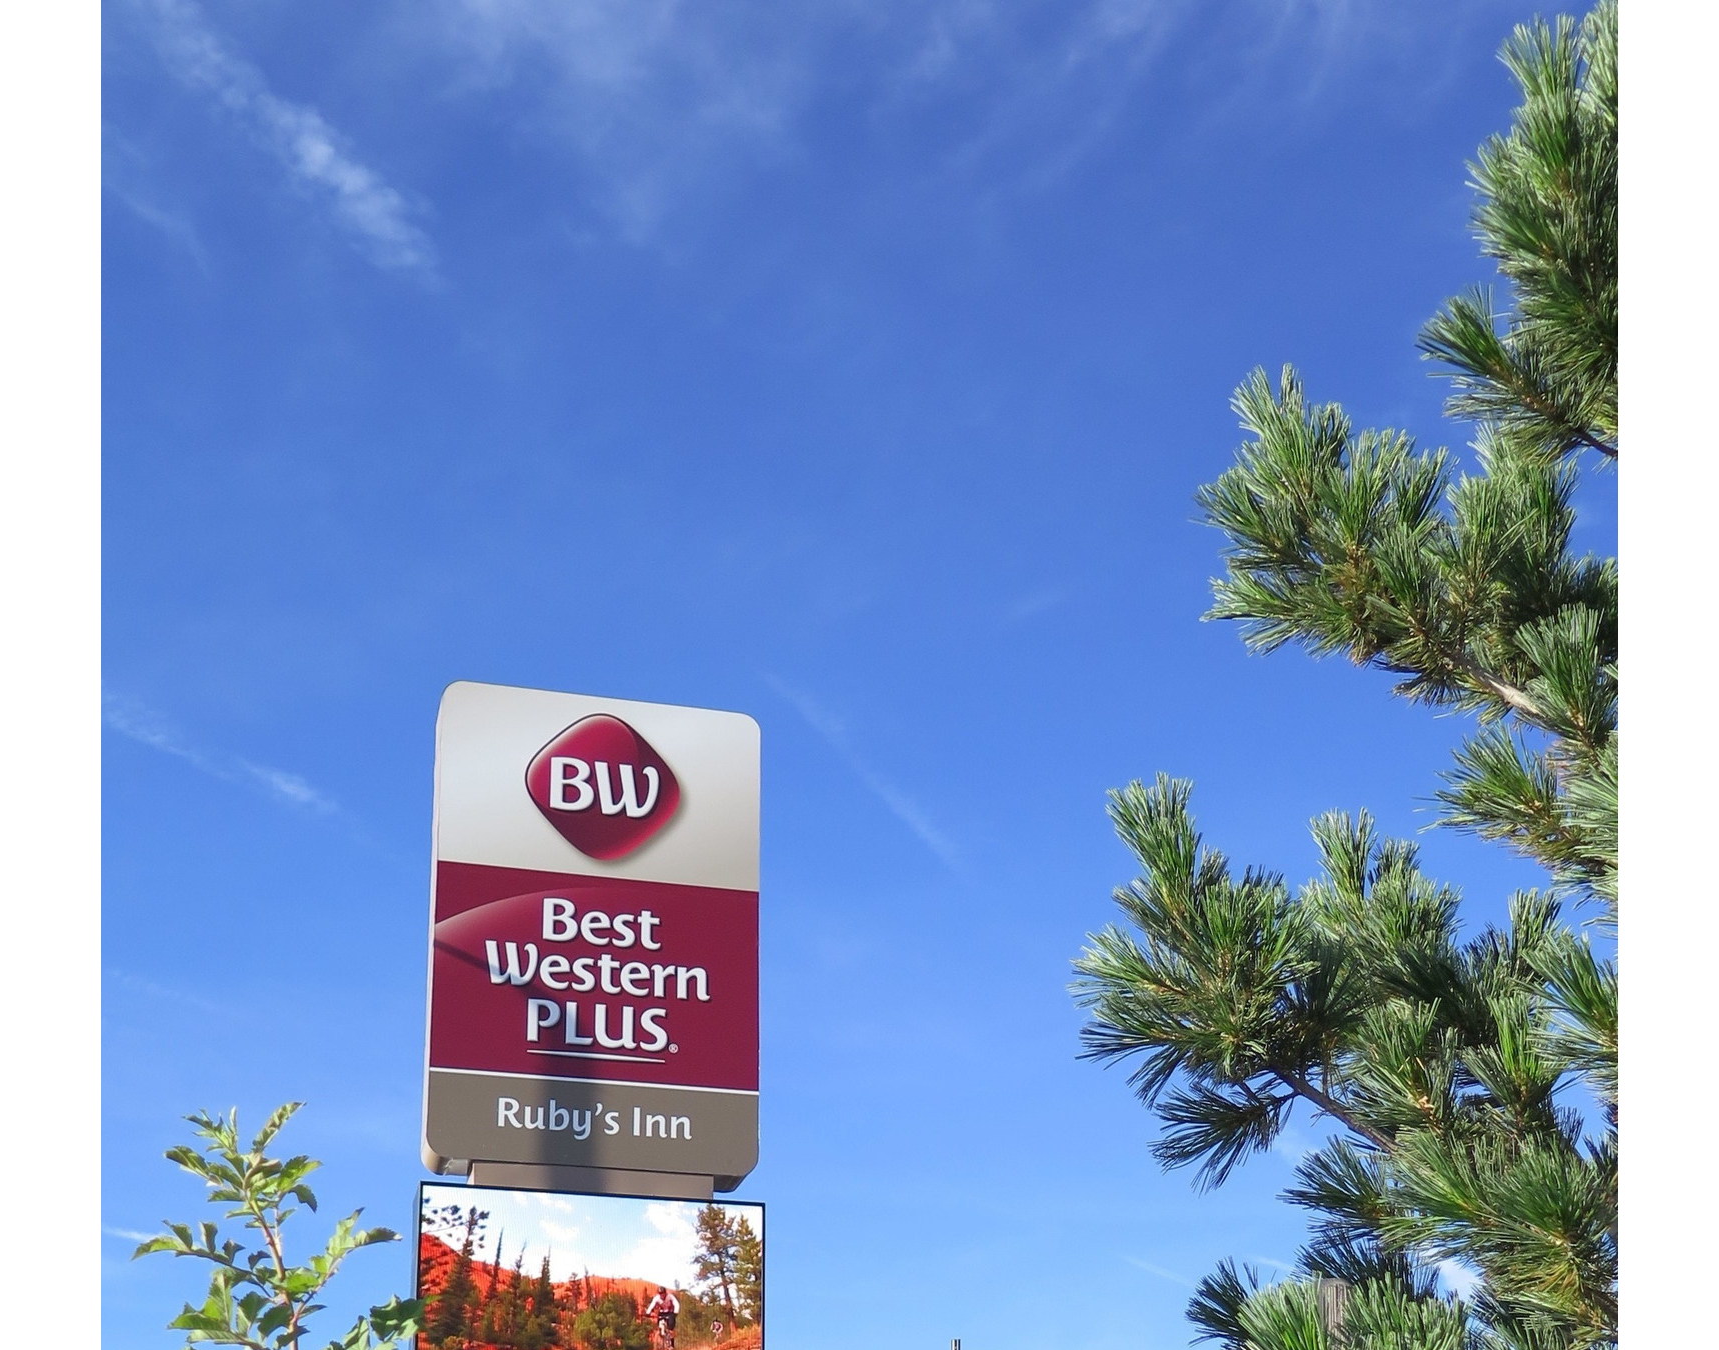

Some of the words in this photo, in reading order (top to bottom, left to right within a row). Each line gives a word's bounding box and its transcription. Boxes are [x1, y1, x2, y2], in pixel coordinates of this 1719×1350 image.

[549, 756, 660, 819] BW
[542, 897, 662, 950] Best
[484, 939, 711, 1002] Western
[526, 998, 669, 1052] PLUS
[497, 1096, 621, 1141] Ruby's
[632, 1106, 693, 1140] Inn
